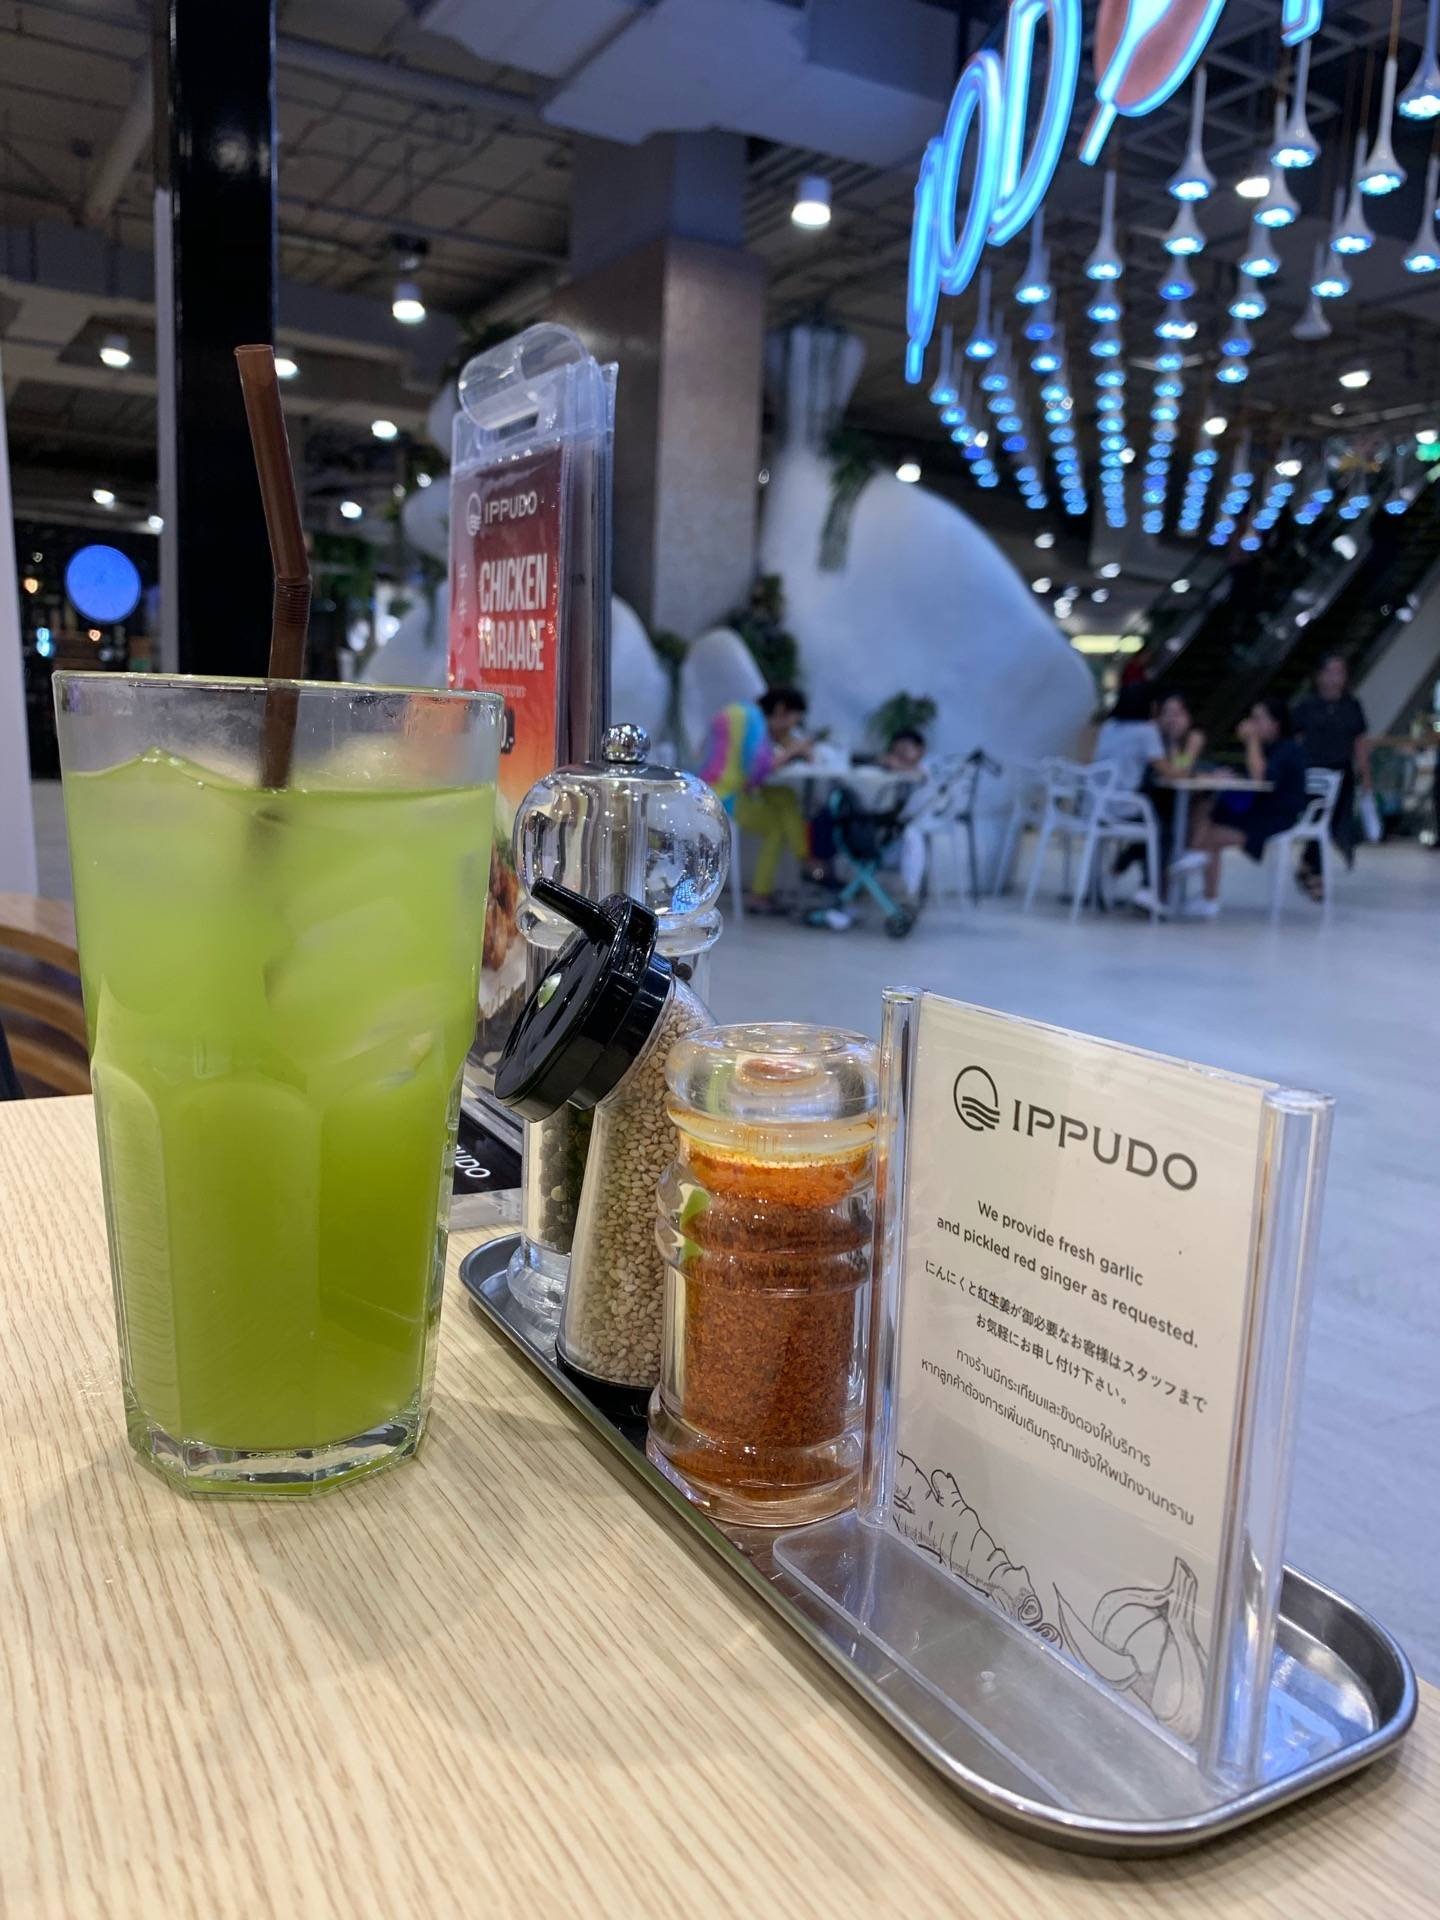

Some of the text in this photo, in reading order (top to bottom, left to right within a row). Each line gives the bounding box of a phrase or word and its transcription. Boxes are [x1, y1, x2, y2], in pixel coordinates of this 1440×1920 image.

[484, 491, 538, 524] IPPUDO
[480, 553, 548, 612] CHICKEN
[479, 617, 545, 671] KARAAGE
[1012, 1099, 1198, 1191] IPPUDO
[937, 1216, 1199, 1348] and pickled red ginger as requested.
[978, 1200, 1144, 1287] We provide fresh garlic
[976, 1313, 1127, 1405] お気軽にお申し付け下さい。
